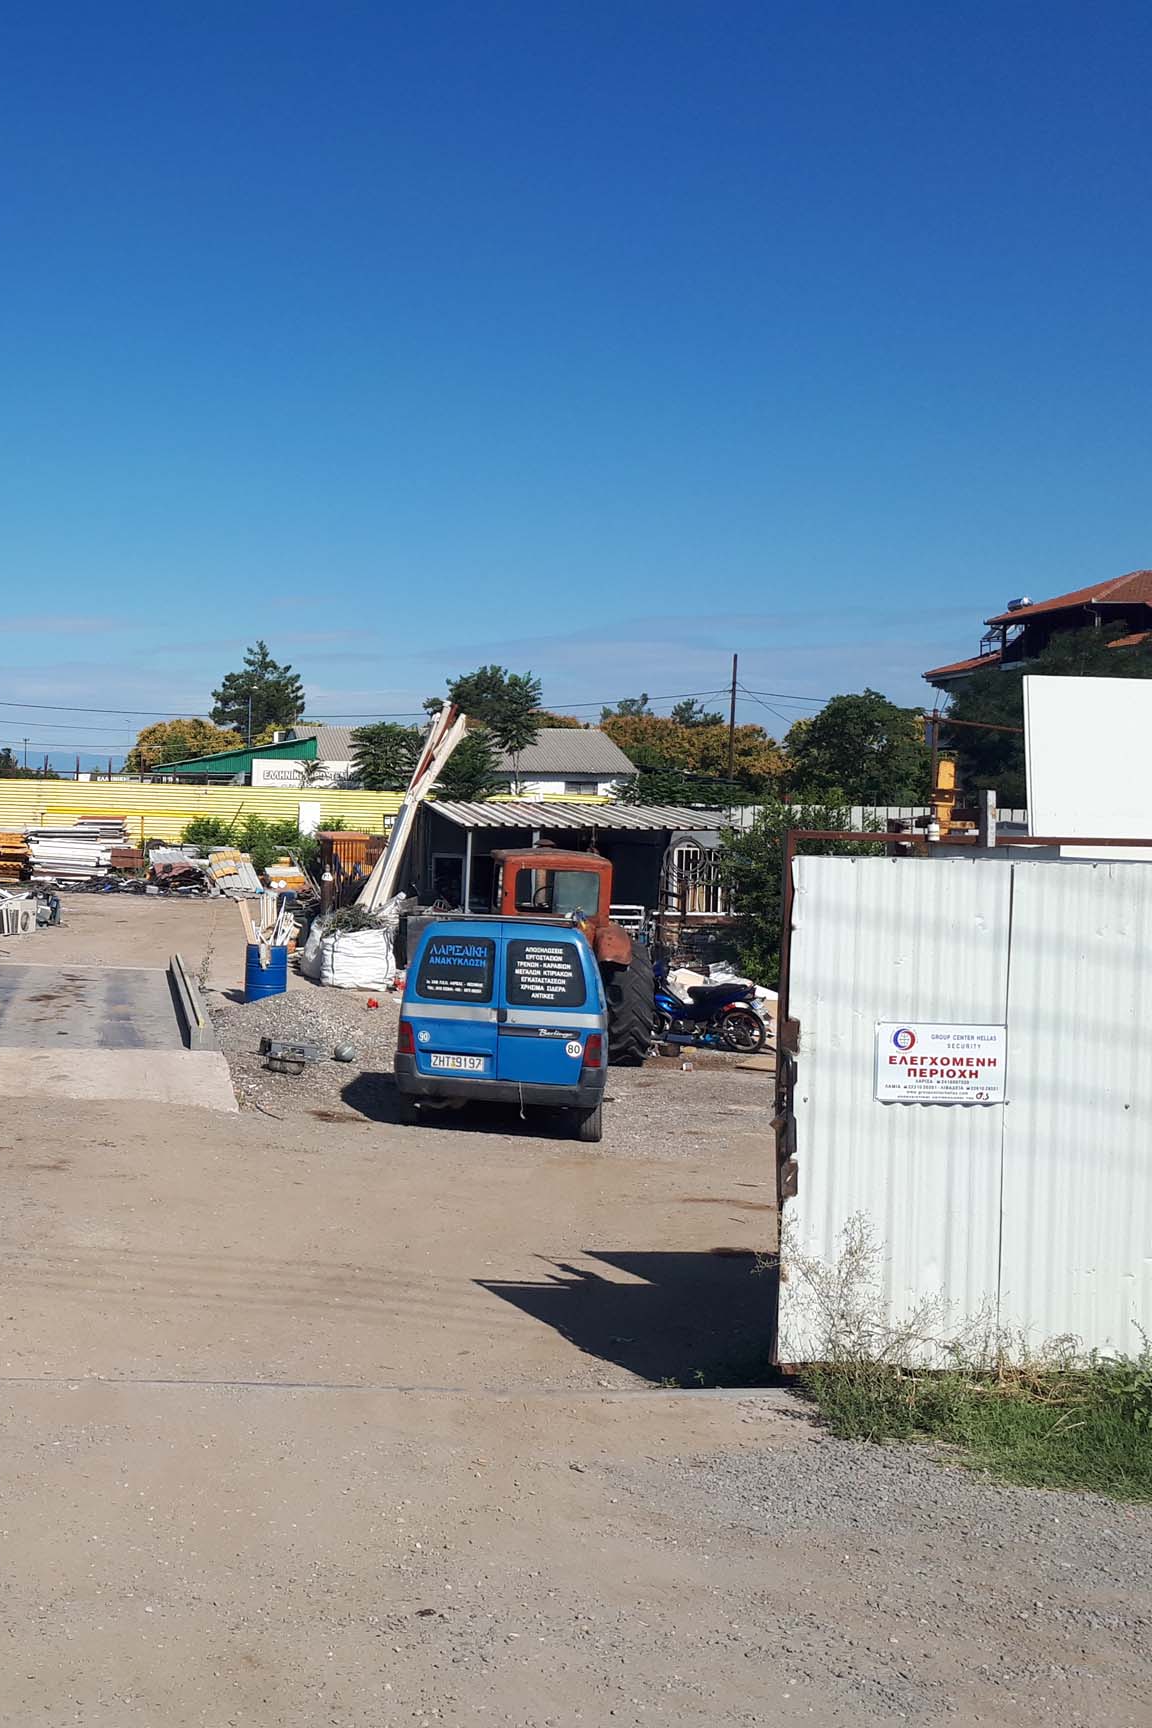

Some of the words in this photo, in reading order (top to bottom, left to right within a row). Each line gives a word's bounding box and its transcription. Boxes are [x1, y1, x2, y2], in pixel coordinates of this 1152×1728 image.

[263, 769, 306, 781] ΕΛΛΗΝΙΚ
[428, 956, 487, 968] ΑΝΑΚΥΚΛΩΣΗ
[543, 962, 572, 970] ΚΑΡΑΒΙΩΝ
[543, 970, 573, 978] ΚΤΙΡΙΑΚΩΝ
[546, 985, 566, 993] ΣΙΔΕΡΑ
[537, 1028, 574, 1038] Berlingo
[567, 1045, 580, 1054] 80
[888, 1055, 997, 1067] ΕΛΕΓΧΟΜΕΝΗ
[907, 1068, 979, 1079] ΠΕΡΙΟΧΗ
